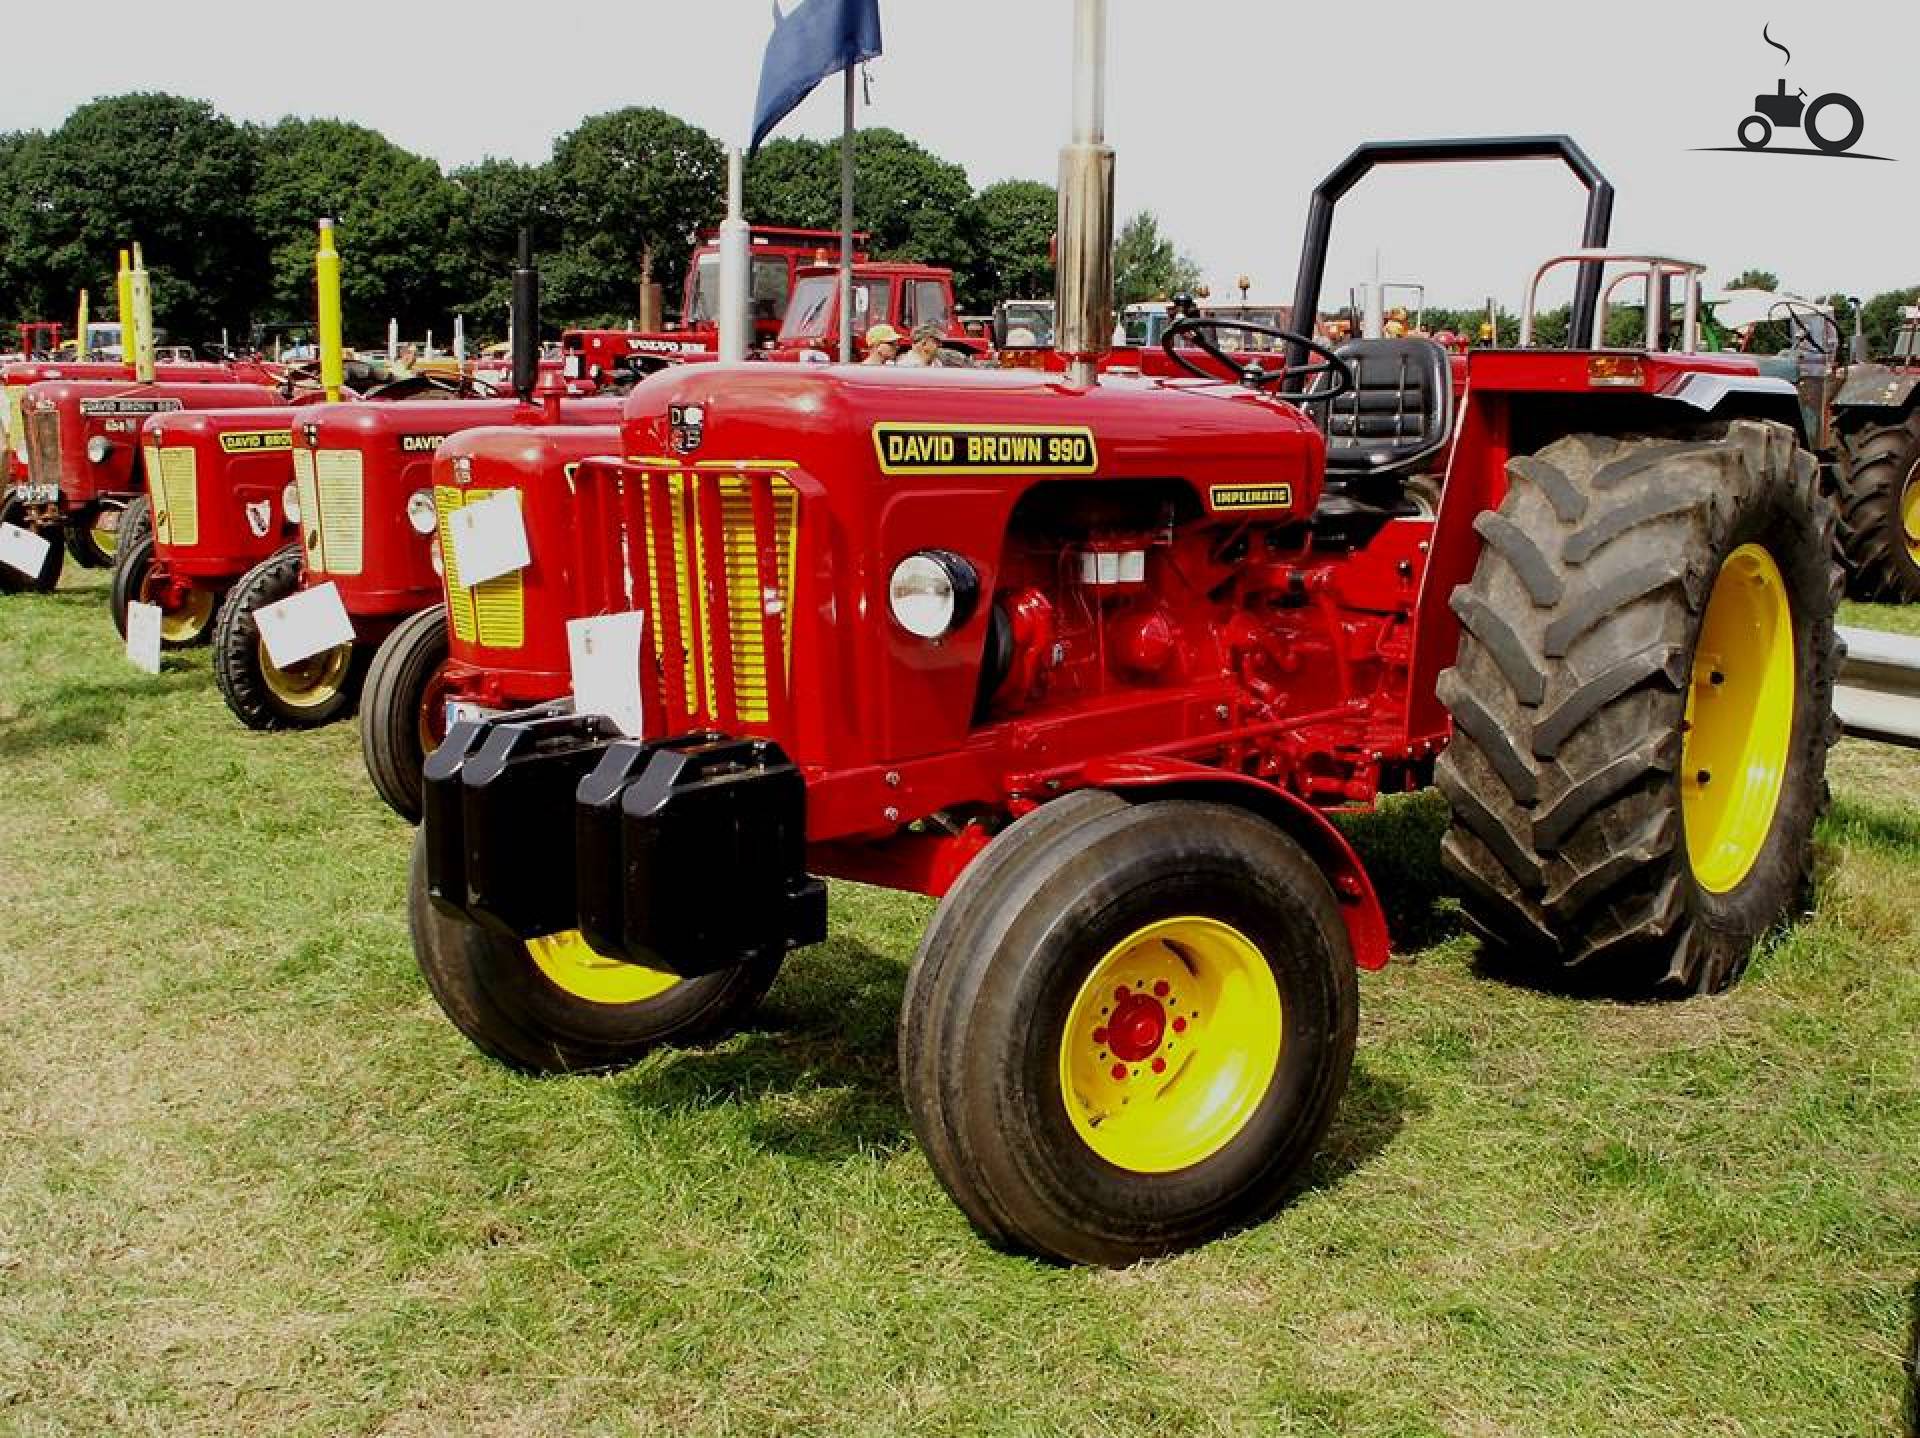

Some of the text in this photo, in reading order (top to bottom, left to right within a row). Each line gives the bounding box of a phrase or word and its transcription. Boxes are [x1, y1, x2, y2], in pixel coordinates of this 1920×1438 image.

[888, 435, 1086, 463] DAVID BROWN 990
[1215, 489, 1288, 503] IMPLEMATIC
